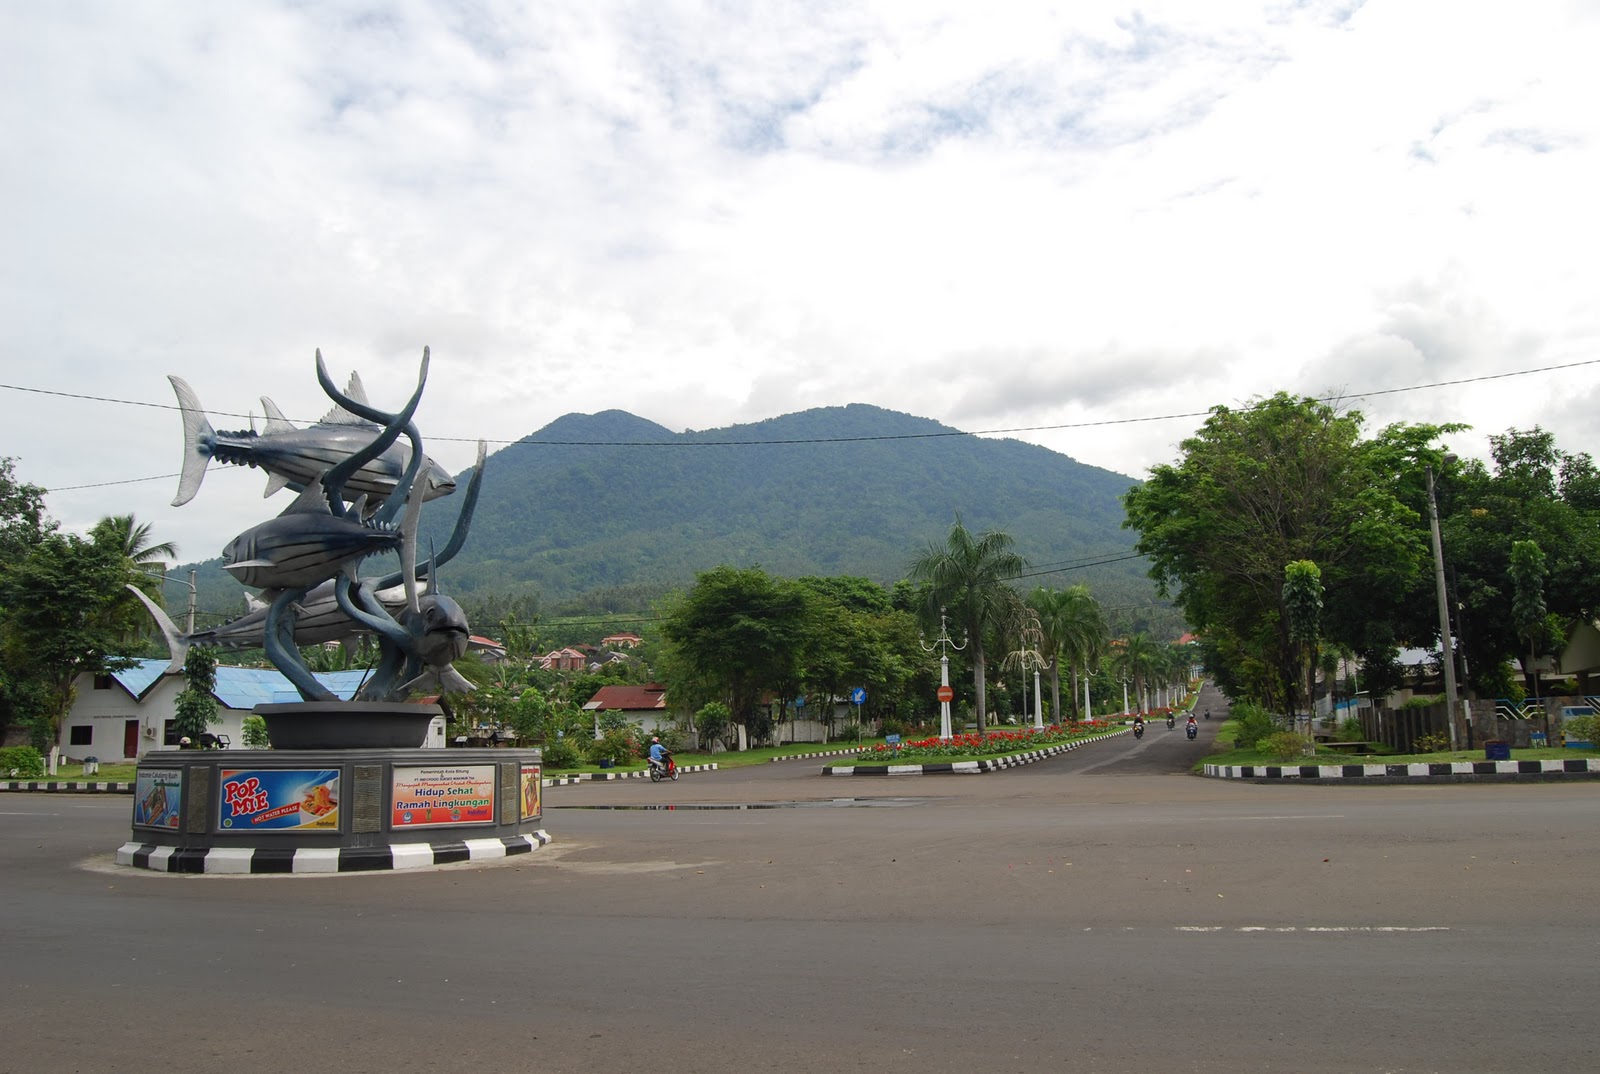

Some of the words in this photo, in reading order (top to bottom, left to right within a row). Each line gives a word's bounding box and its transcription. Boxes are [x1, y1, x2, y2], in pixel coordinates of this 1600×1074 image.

[224, 776, 260, 803] POP
[415, 788, 445, 797] Hidup
[447, 787, 474, 796] Sehat
[231, 790, 270, 816] MIE
[396, 800, 431, 809] Ramah
[433, 798, 490, 809] Lingkungan
[265, 810, 280, 819] WATER
[281, 805, 298, 814] PLEASE
